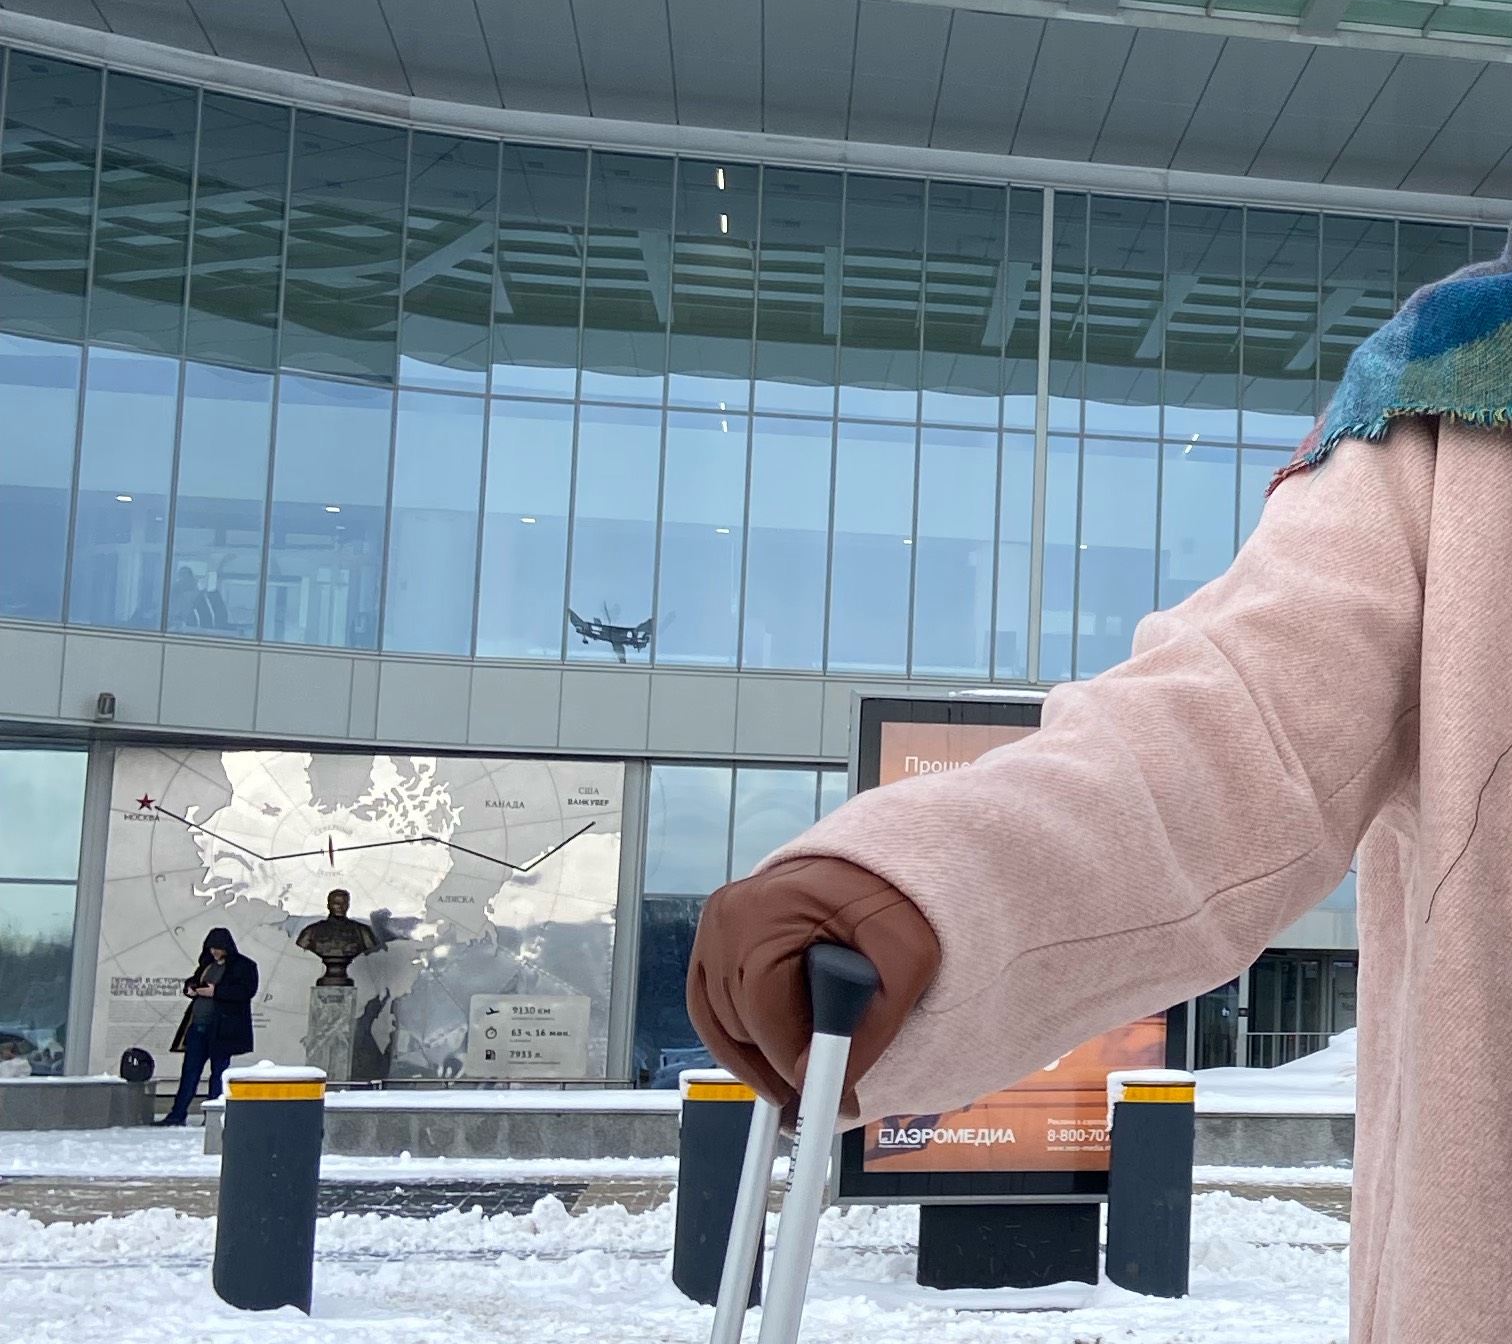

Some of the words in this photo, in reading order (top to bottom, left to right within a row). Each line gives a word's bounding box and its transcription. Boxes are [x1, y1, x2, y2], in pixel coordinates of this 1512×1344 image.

[904, 756, 971, 776] Прош
[485, 800, 525, 809] КАНАДА
[123, 813, 160, 822] МОСКВА
[535, 1029, 546, 1037] 16
[894, 1128, 1016, 1146] АЭРОМЕДИА
